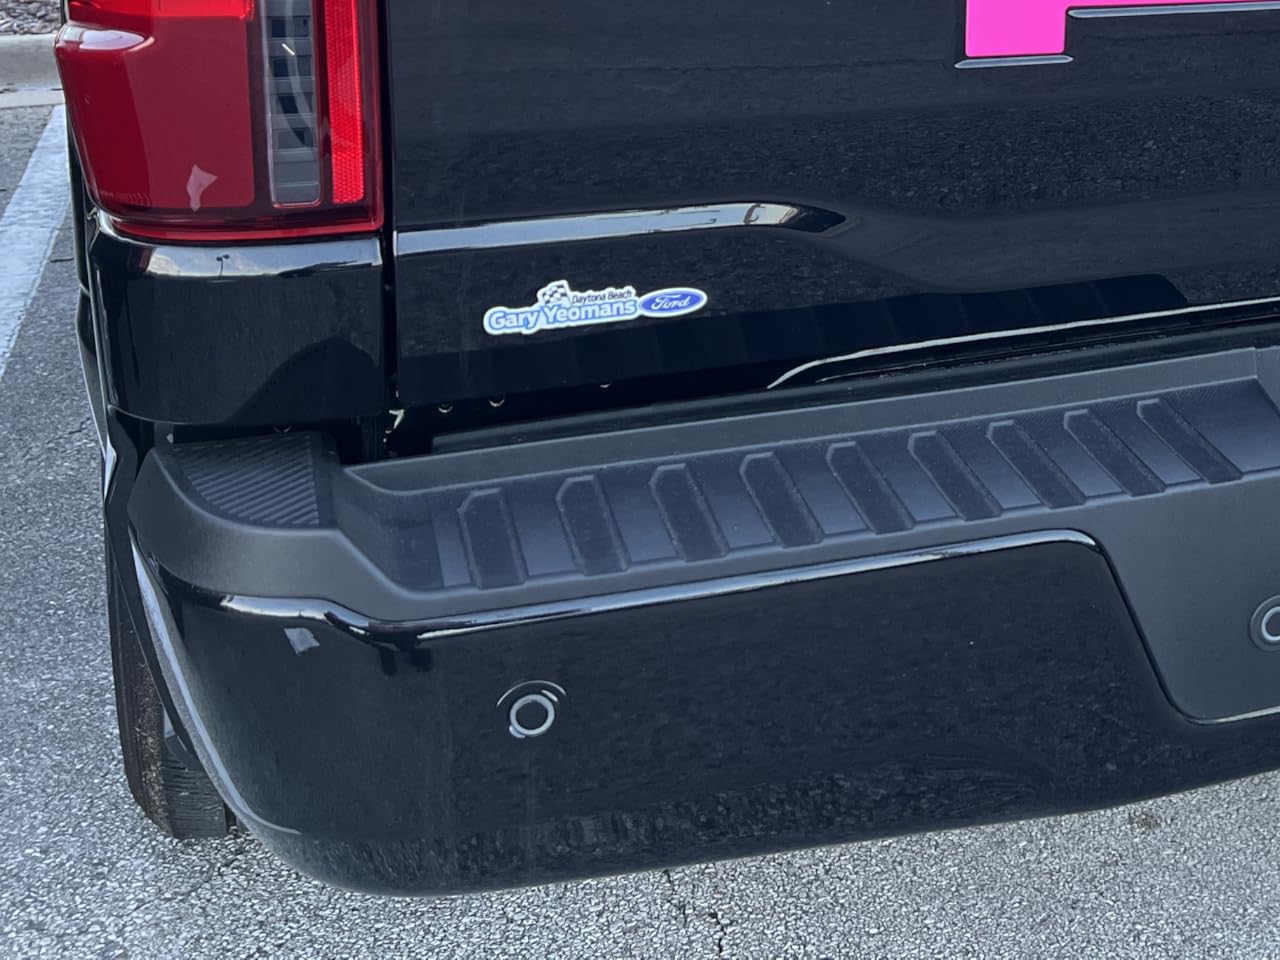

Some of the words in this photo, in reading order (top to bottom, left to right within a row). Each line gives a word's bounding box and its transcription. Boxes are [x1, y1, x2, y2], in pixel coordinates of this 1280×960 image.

[572, 292, 606, 306] Daytona
[608, 289, 632, 300] Beach
[651, 294, 691, 310] Ford
[488, 310, 540, 330] Gary
[542, 299, 638, 324] Yeomans
